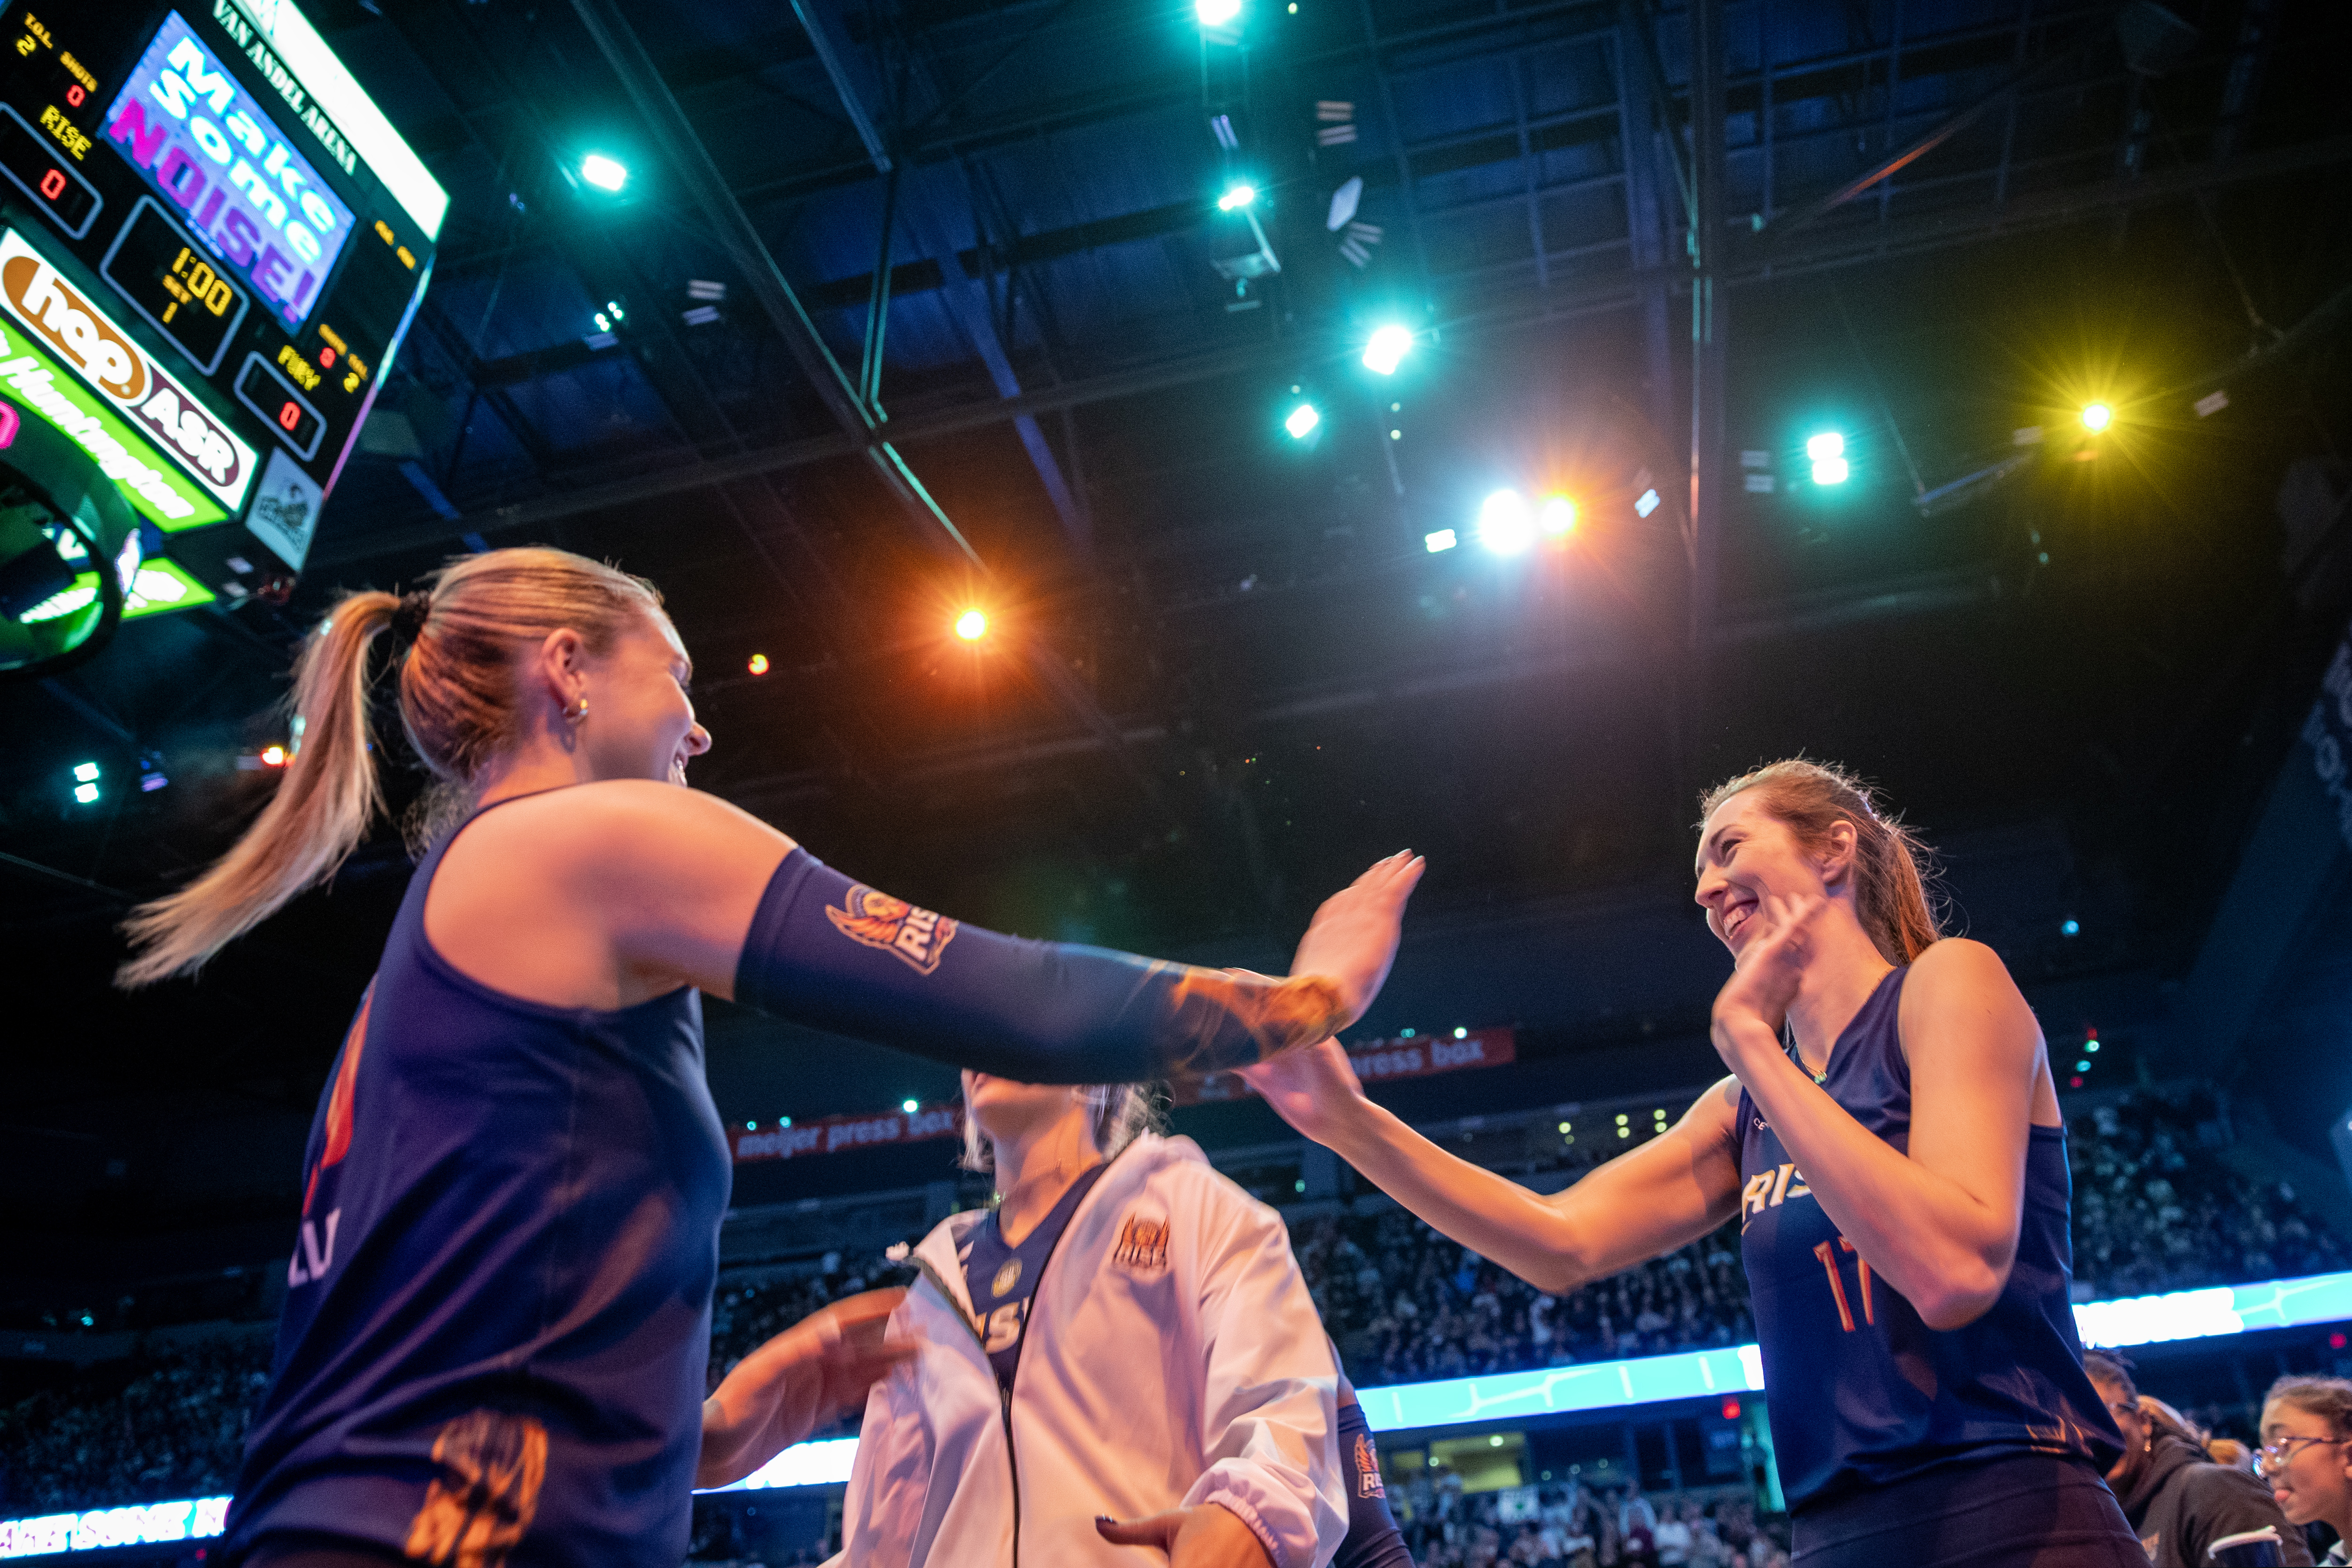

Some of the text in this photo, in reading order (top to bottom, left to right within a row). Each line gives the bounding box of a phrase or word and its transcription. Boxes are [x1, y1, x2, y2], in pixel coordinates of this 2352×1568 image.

[16, 34, 85, 108] 2 0
[212, 0, 357, 176] VAN ANDEL ARENA
[40, 104, 92, 161] RISE
[148, 68, 322, 264] Some
[166, 35, 337, 234] Make
[40, 168, 67, 200] 0
[108, 97, 315, 324] NOISE!
[162, 302, 178, 324] 1
[172, 247, 233, 317] 1:00
[0, 355, 195, 520] Huntington
[140, 387, 235, 485] ASR
[279, 402, 301, 431] 0
